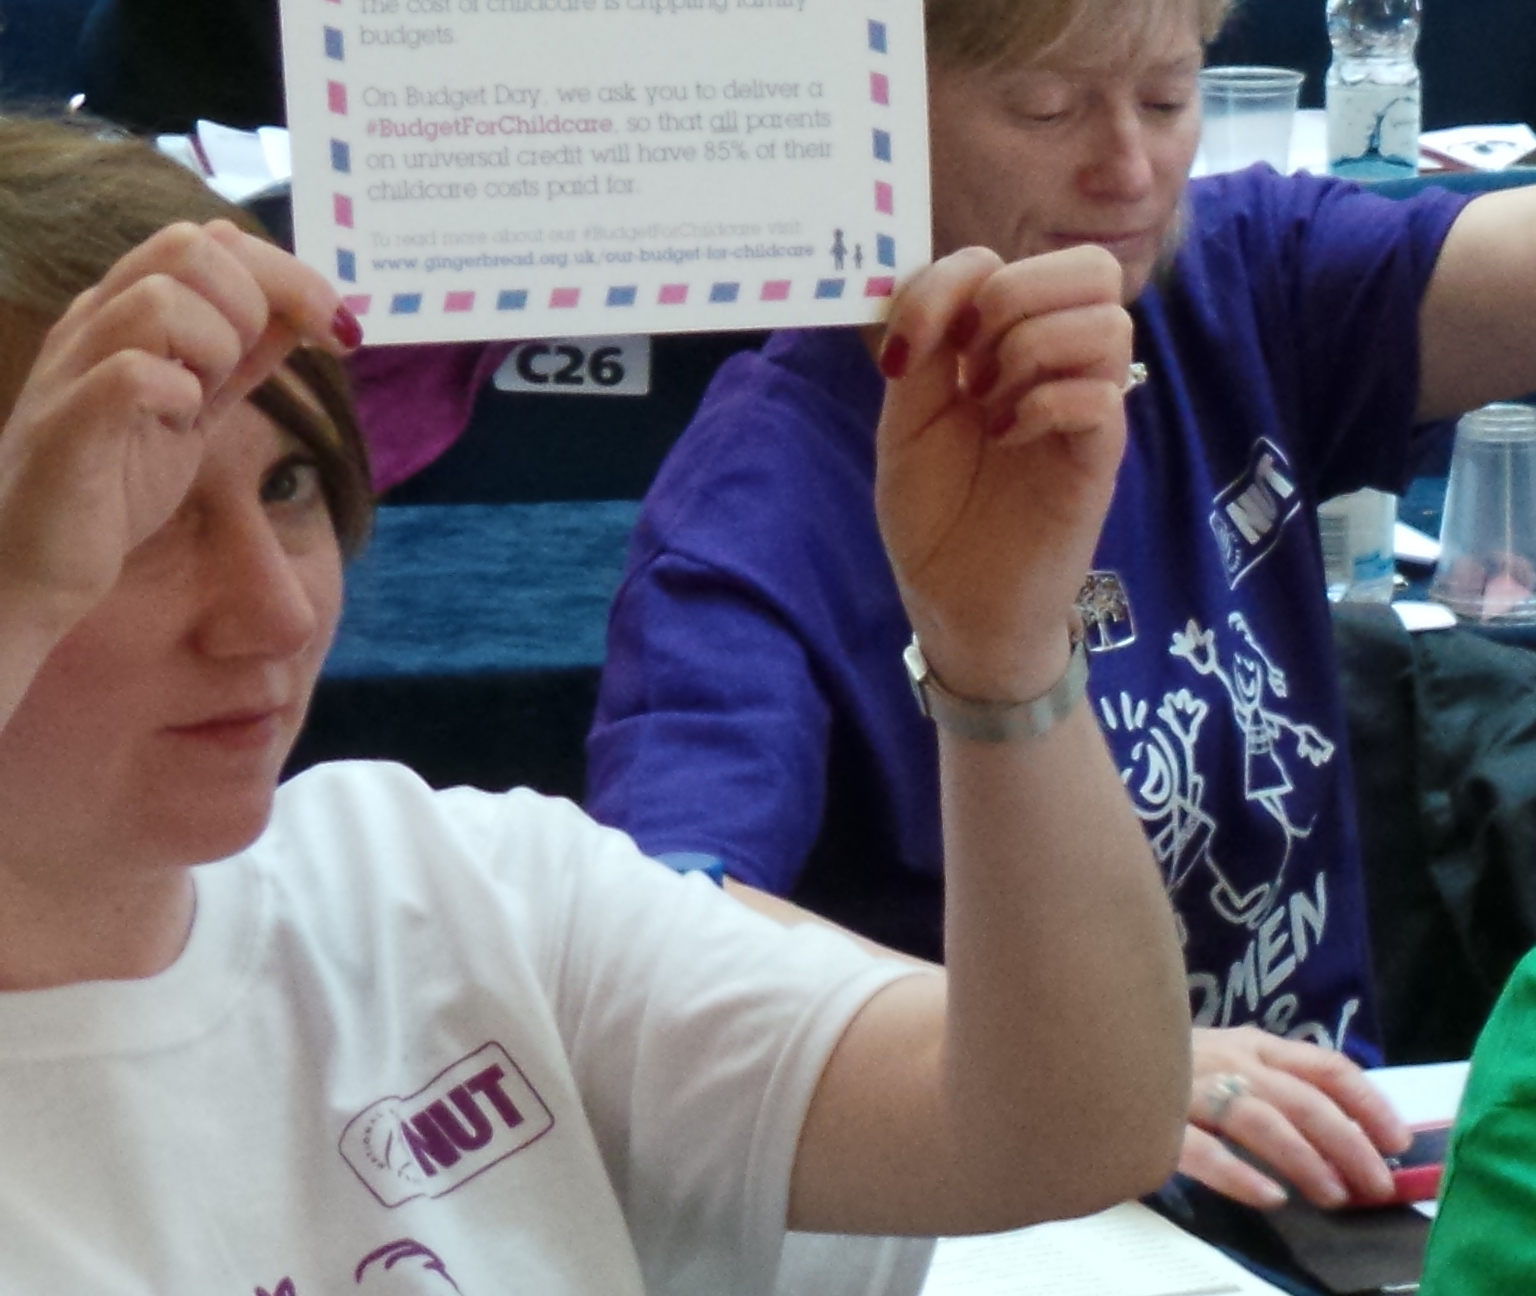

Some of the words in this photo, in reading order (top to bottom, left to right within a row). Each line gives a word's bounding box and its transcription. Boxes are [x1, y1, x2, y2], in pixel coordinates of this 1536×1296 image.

[361, 86, 397, 107] On
[405, 85, 487, 109] Budget
[556, 86, 592, 103] we
[596, 82, 638, 103] ask
[643, 84, 689, 106] you
[693, 82, 717, 100] to
[722, 79, 800, 99] deliver
[806, 82, 824, 98] a
[625, 116, 652, 132] so
[655, 112, 703, 131] that
[708, 111, 738, 132] all
[745, 110, 832, 134] parents
[364, 153, 395, 171] on
[403, 147, 510, 169] universal
[516, 146, 583, 166] credit
[589, 143, 630, 164] will
[636, 143, 697, 163] have
[702, 140, 750, 161] 85%
[753, 141, 777, 160] of
[783, 140, 831, 159] their
[366, 181, 478, 202] childcare
[483, 179, 540, 199] costs
[545, 175, 598, 201] paid
[516, 344, 625, 386] C26
[1226, 454, 1294, 545] NUT
[401, 1064, 524, 1177] NUT
